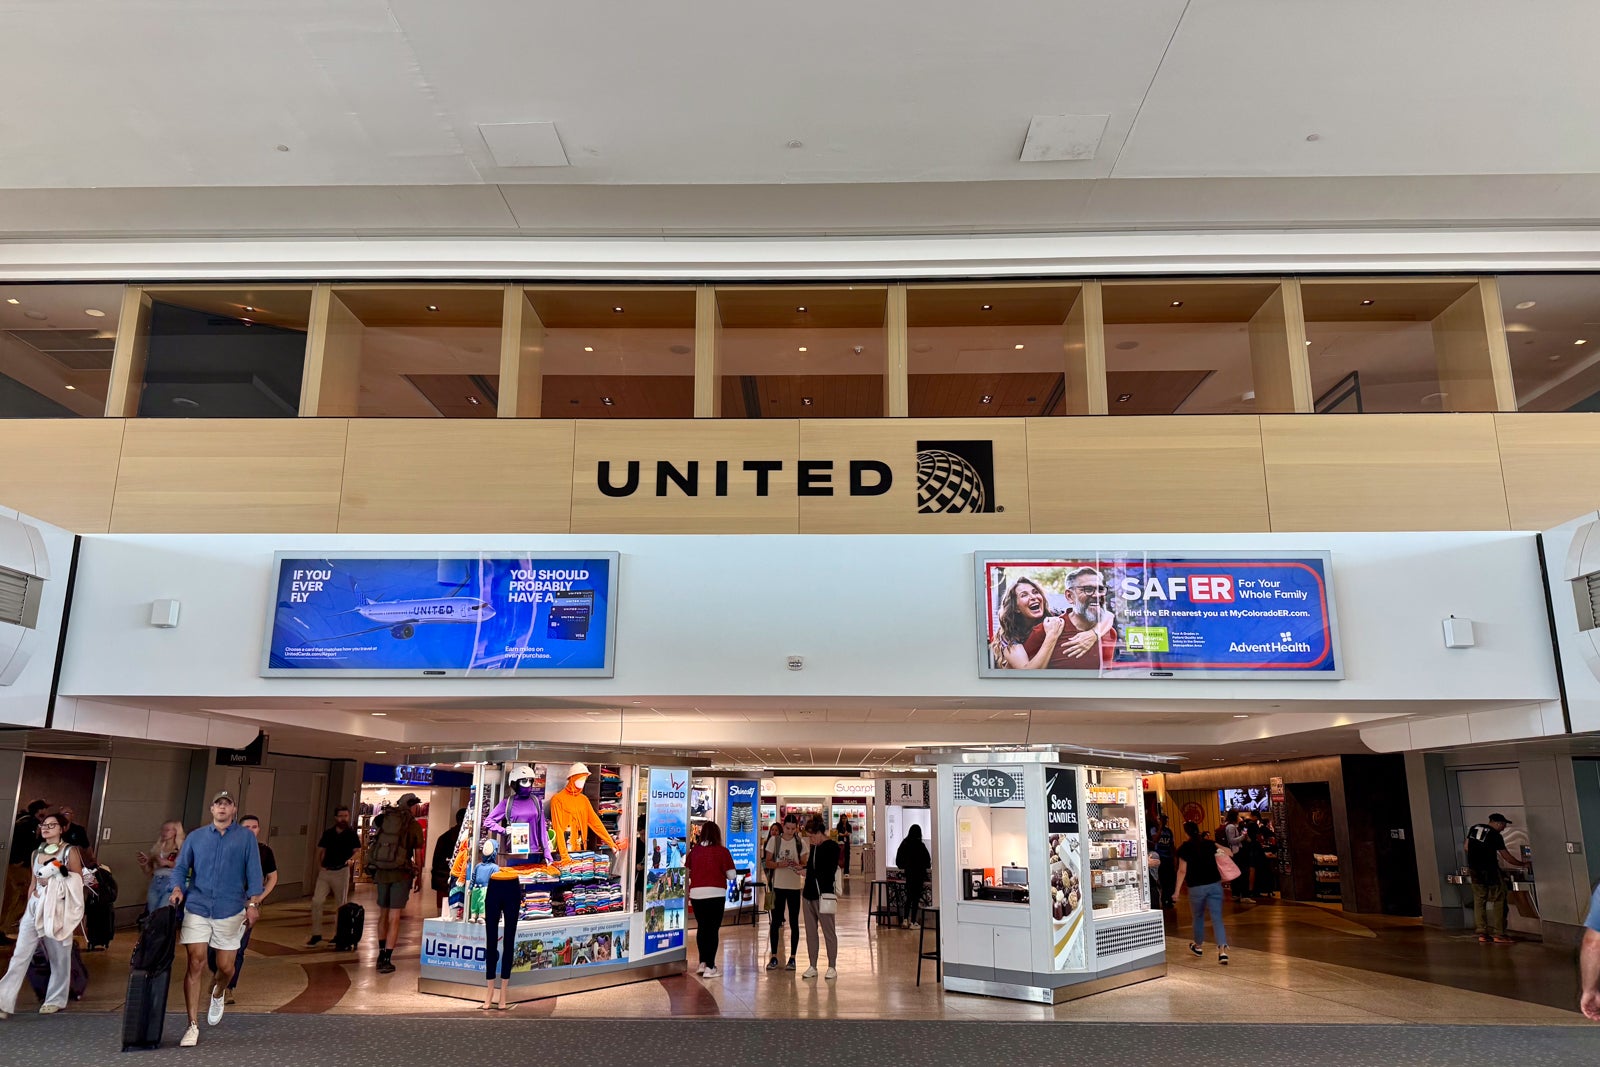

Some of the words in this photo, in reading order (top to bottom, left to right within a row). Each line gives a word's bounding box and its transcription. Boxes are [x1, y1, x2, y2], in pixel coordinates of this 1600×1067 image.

[597, 460, 893, 497] UNITED
[293, 570, 304, 580] IF
[306, 570, 331, 580] YOU
[510, 570, 536, 580] YOU
[538, 570, 589, 580] SHOULD
[292, 582, 323, 592] EVER
[509, 581, 573, 591] PROBABLY
[1121, 577, 1232, 600] SAFER
[1238, 580, 1255, 588] For
[1258, 580, 1280, 588] Your
[290, 592, 310, 602] FLY
[508, 592, 543, 602] HAVE
[544, 592, 554, 602] A
[1239, 590, 1272, 599] Whole
[1274, 590, 1308, 600] Family
[414, 606, 453, 615] UNITED
[1230, 610, 1310, 618] MyColoradoER.com.
[230, 754, 247, 762] Men
[972, 774, 1004, 786] See's
[652, 790, 685, 799] USHOOD
[967, 788, 1010, 798] CANDIES
[1051, 794, 1072, 810] See's
[1048, 812, 1076, 823] CANDIES
